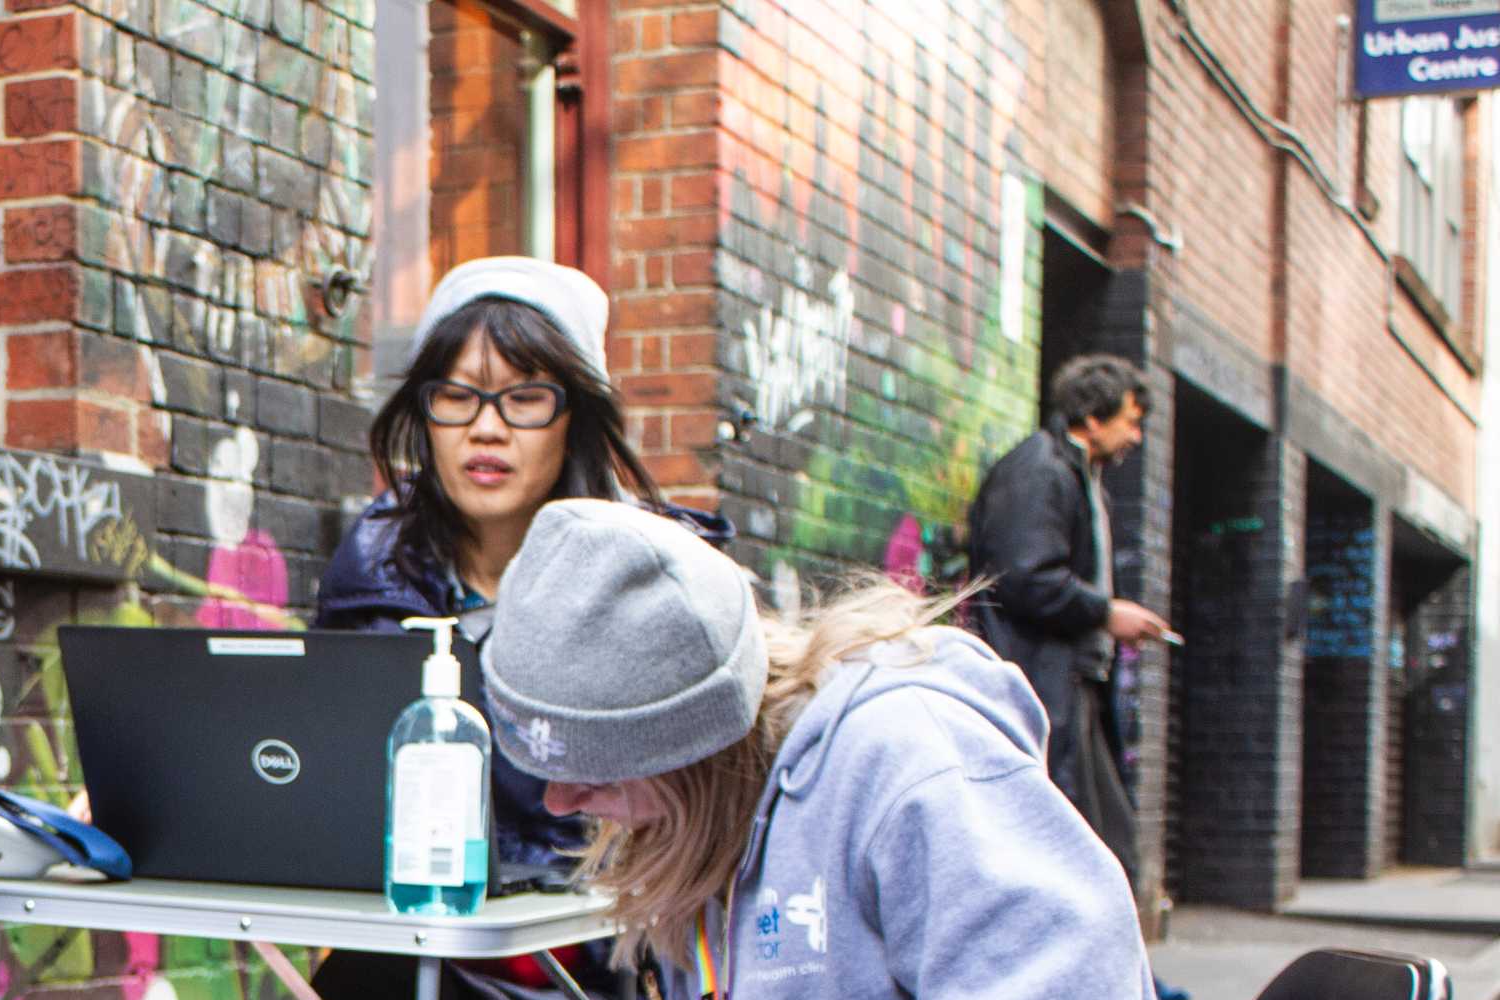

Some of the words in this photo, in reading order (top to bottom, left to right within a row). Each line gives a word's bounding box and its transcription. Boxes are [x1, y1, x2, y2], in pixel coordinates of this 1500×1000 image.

[1363, 28, 1449, 57] Urban
[1454, 24, 1500, 50] Jus
[1407, 56, 1499, 82] Centre
[259, 753, 294, 770] DELL
